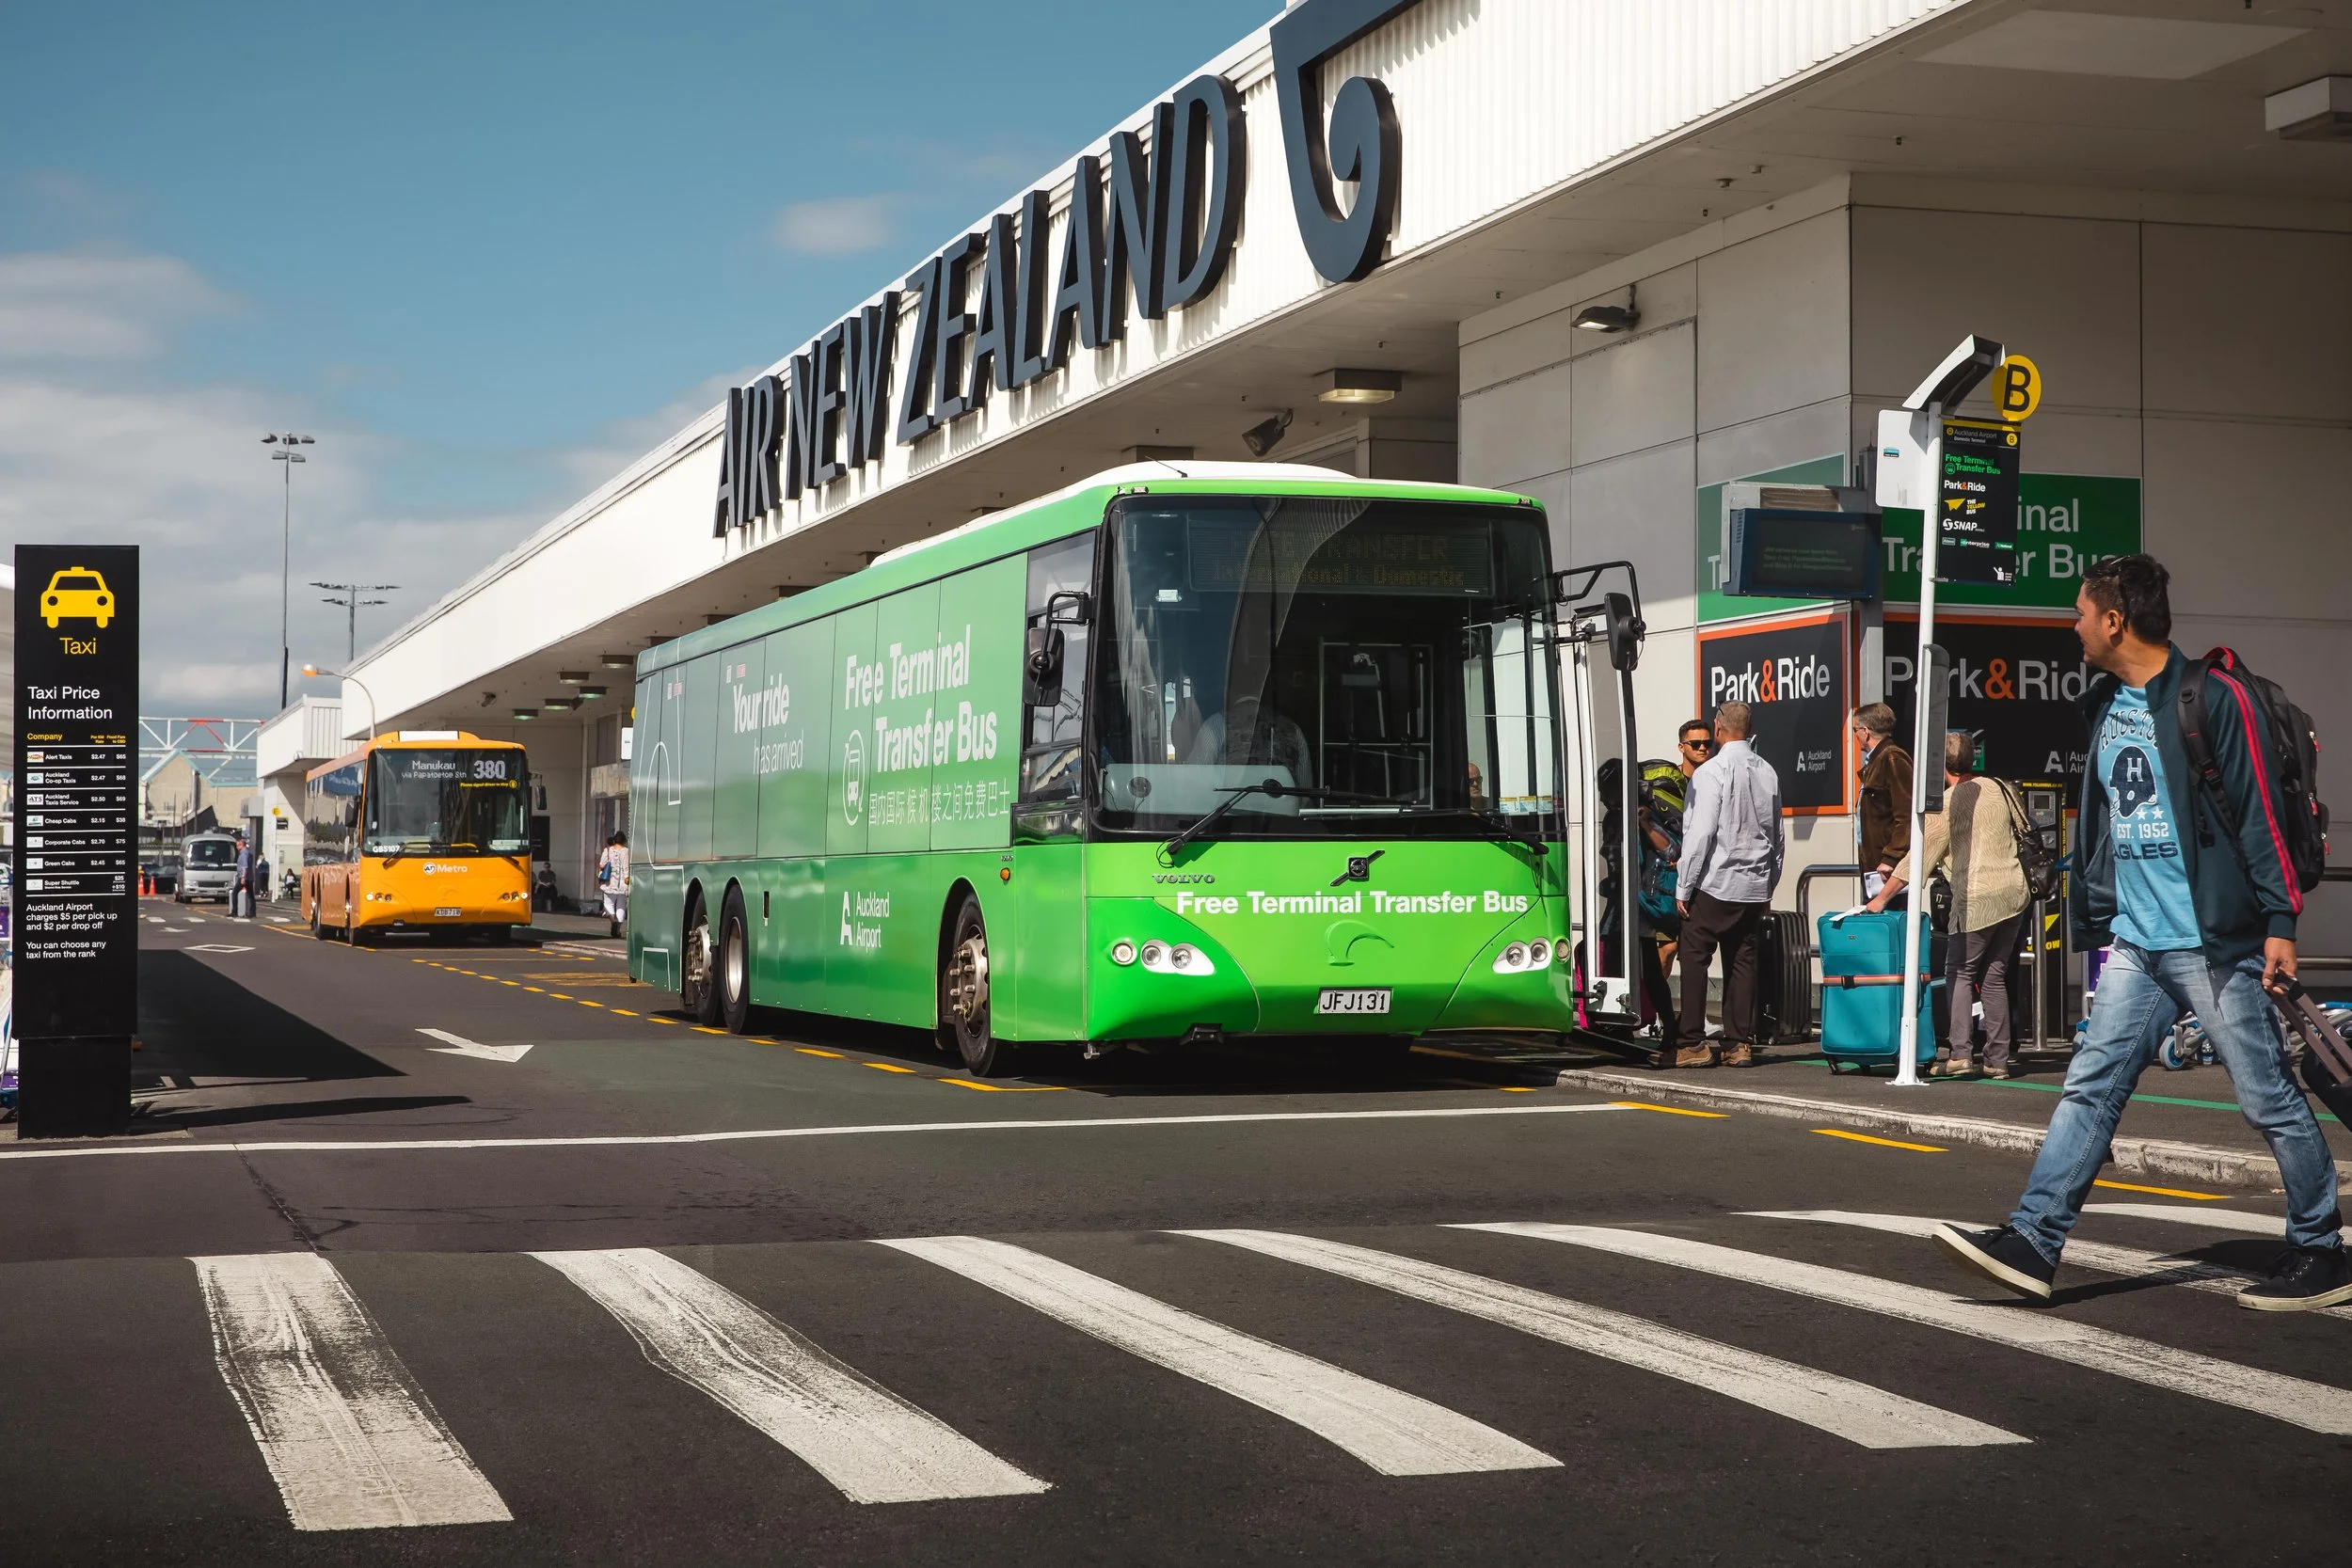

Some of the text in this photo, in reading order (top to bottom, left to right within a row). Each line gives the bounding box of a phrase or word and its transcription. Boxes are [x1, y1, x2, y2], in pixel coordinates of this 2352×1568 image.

[714, 74, 1246, 538] AIR NEW ZEALAND
[2003, 363, 2031, 412] B
[1945, 453, 1994, 466] Free Terminal
[1956, 463, 2001, 475] Transfer Bus
[1944, 480, 1986, 492] Park&Ride
[2017, 496, 2079, 532] inal
[1953, 520, 1978, 531] SNAP
[2049, 544, 2119, 578] Bu
[59, 638, 96, 654] Taxi
[846, 624, 971, 709] Free Terminal
[1710, 655, 1830, 707] Park&Ride
[1884, 656, 2107, 703] Prk&Rid
[27, 686, 100, 700] Taxi Price
[733, 673, 789, 734] Your ride
[28, 706, 112, 720] Information
[27, 733, 62, 741] Company
[876, 701, 997, 772] Transfer Bus
[2100, 708, 2159, 752] HOUSTO
[754, 729, 804, 775] has arrived
[1807, 749, 1832, 760] Auckland
[412, 760, 455, 770] Manukau
[1807, 761, 1826, 772] Airport
[2126, 757, 2144, 782] H
[2117, 822, 2169, 839] EST. 1952
[2114, 841, 2179, 860] GLES
[437, 864, 468, 873] Metro
[1152, 874, 1216, 885] VOLVO
[26, 903, 93, 912] Auckland Airport
[856, 891, 890, 918] Auckland
[1177, 890, 1528, 914] Free Terminal Transfer Bus
[26, 913, 58, 922] charges
[60, 912, 71, 921] $5
[87, 912, 104, 922] pick
[106, 913, 118, 922] up
[43, 922, 54, 931] $2
[72, 922, 90, 931] drop
[91, 921, 103, 929] off
[856, 921, 882, 951] Airport
[60, 941, 90, 949] choose
[91, 942, 106, 950] any
[42, 950, 61, 958] from
[1322, 992, 1386, 1011] JFJ131
